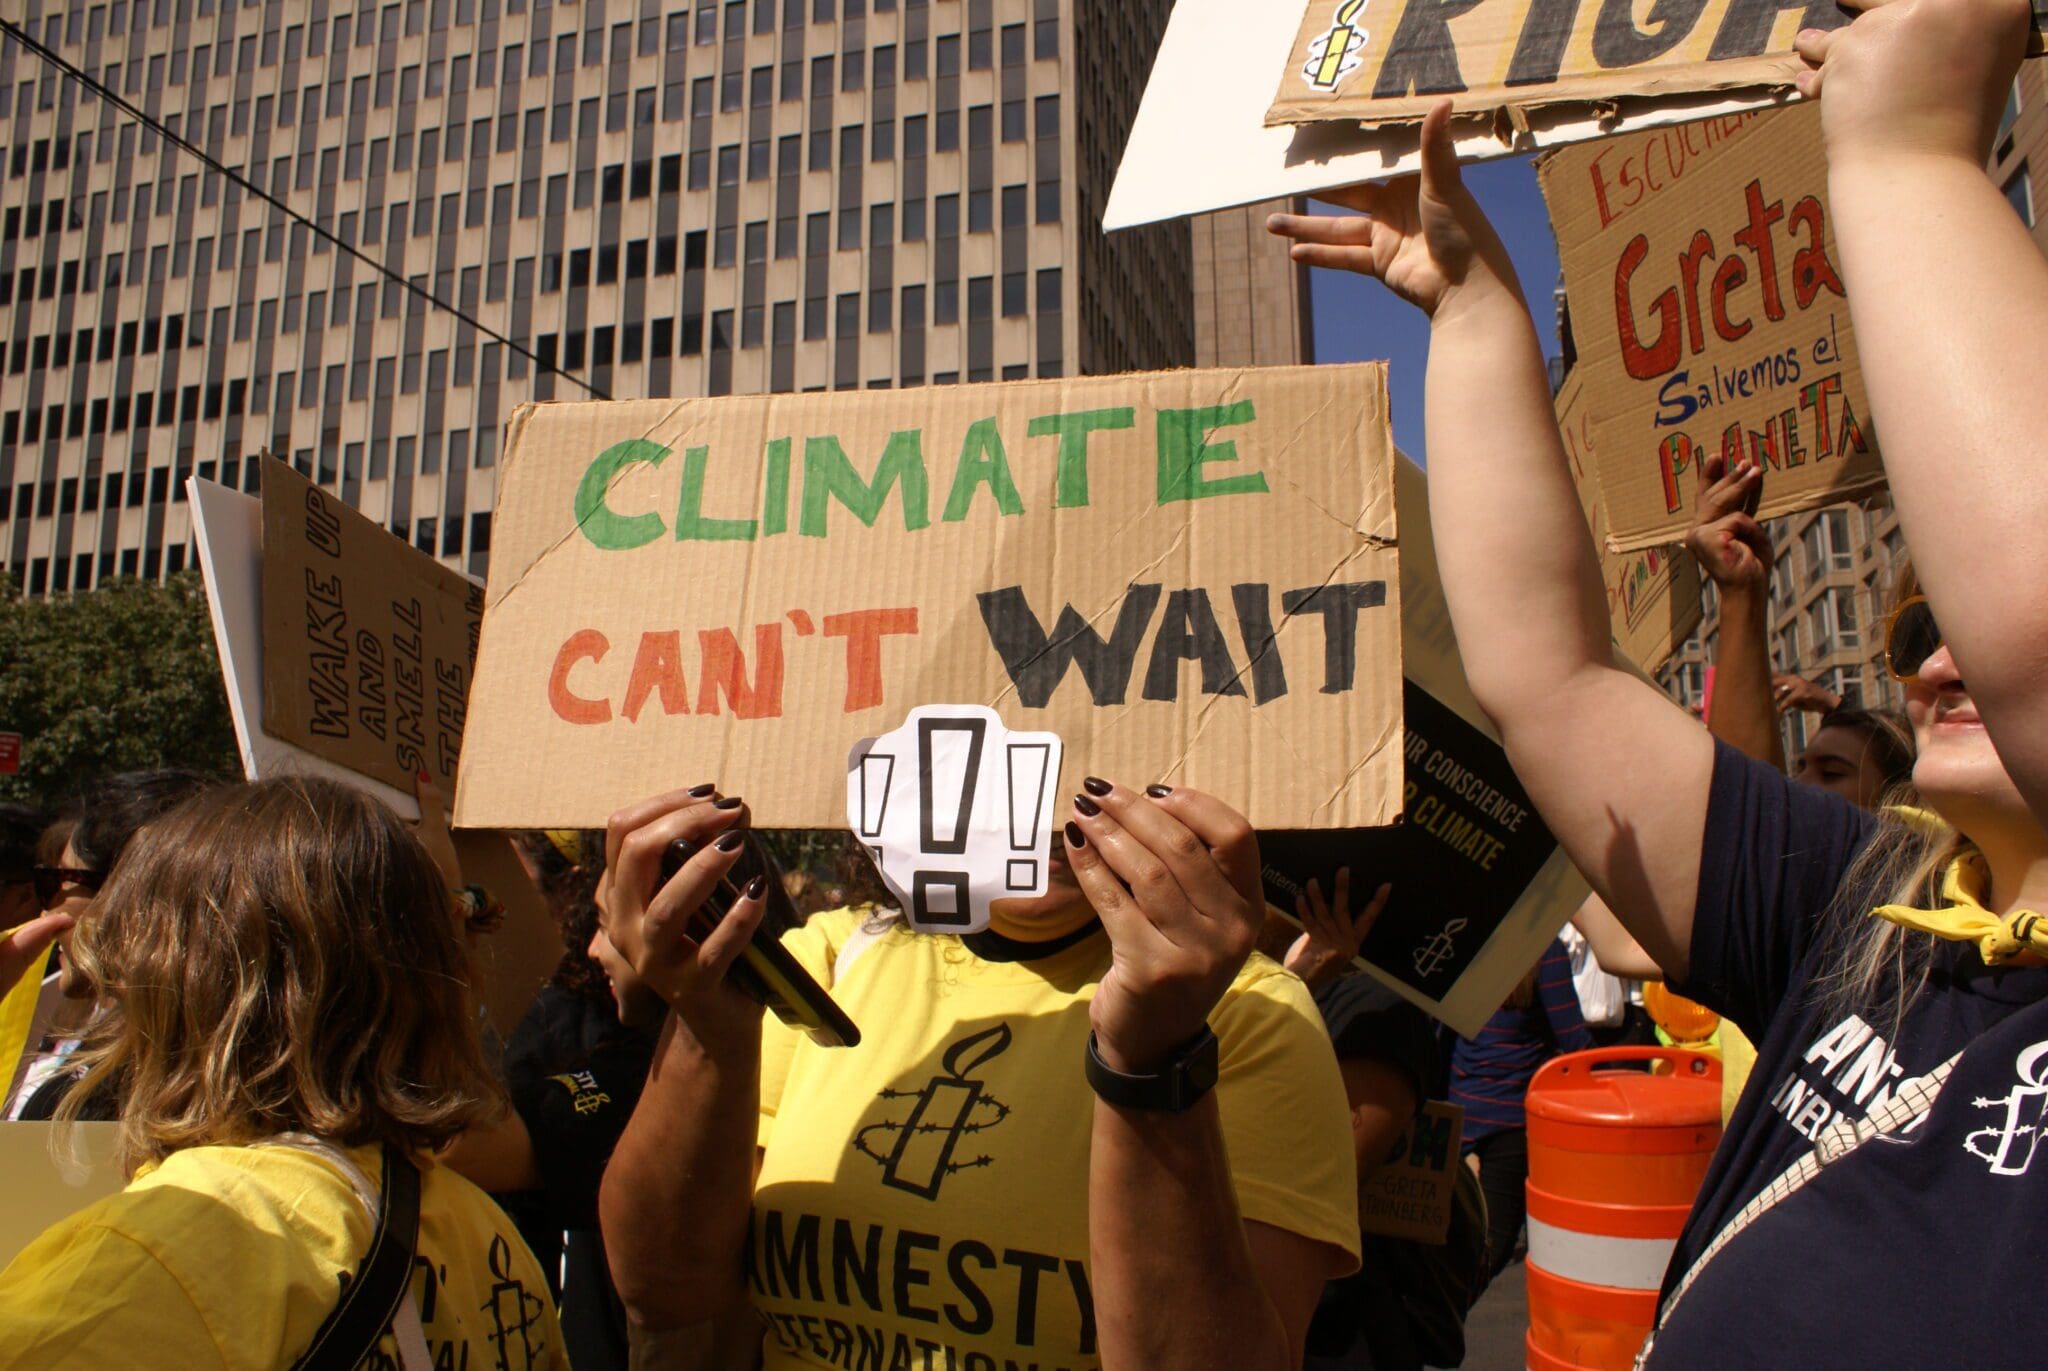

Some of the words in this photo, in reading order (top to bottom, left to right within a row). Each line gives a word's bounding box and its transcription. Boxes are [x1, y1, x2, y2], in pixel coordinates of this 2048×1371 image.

[1615, 178, 1847, 380] Greta
[1654, 347, 1800, 428] Salvemos
[1813, 313, 1842, 365] el
[305, 486, 341, 558] UP
[573, 400, 1269, 550] CLIMATE
[305, 567, 350, 739] WAKE
[356, 628, 387, 742] AND
[392, 598, 426, 774] SMELL
[548, 607, 918, 724] CAN'T
[977, 580, 1386, 707] WAIT
[436, 658, 464, 777] THE
[1413, 795, 1506, 871] CLIMATE
[1424, 749, 1528, 833] CONSCIENCE
